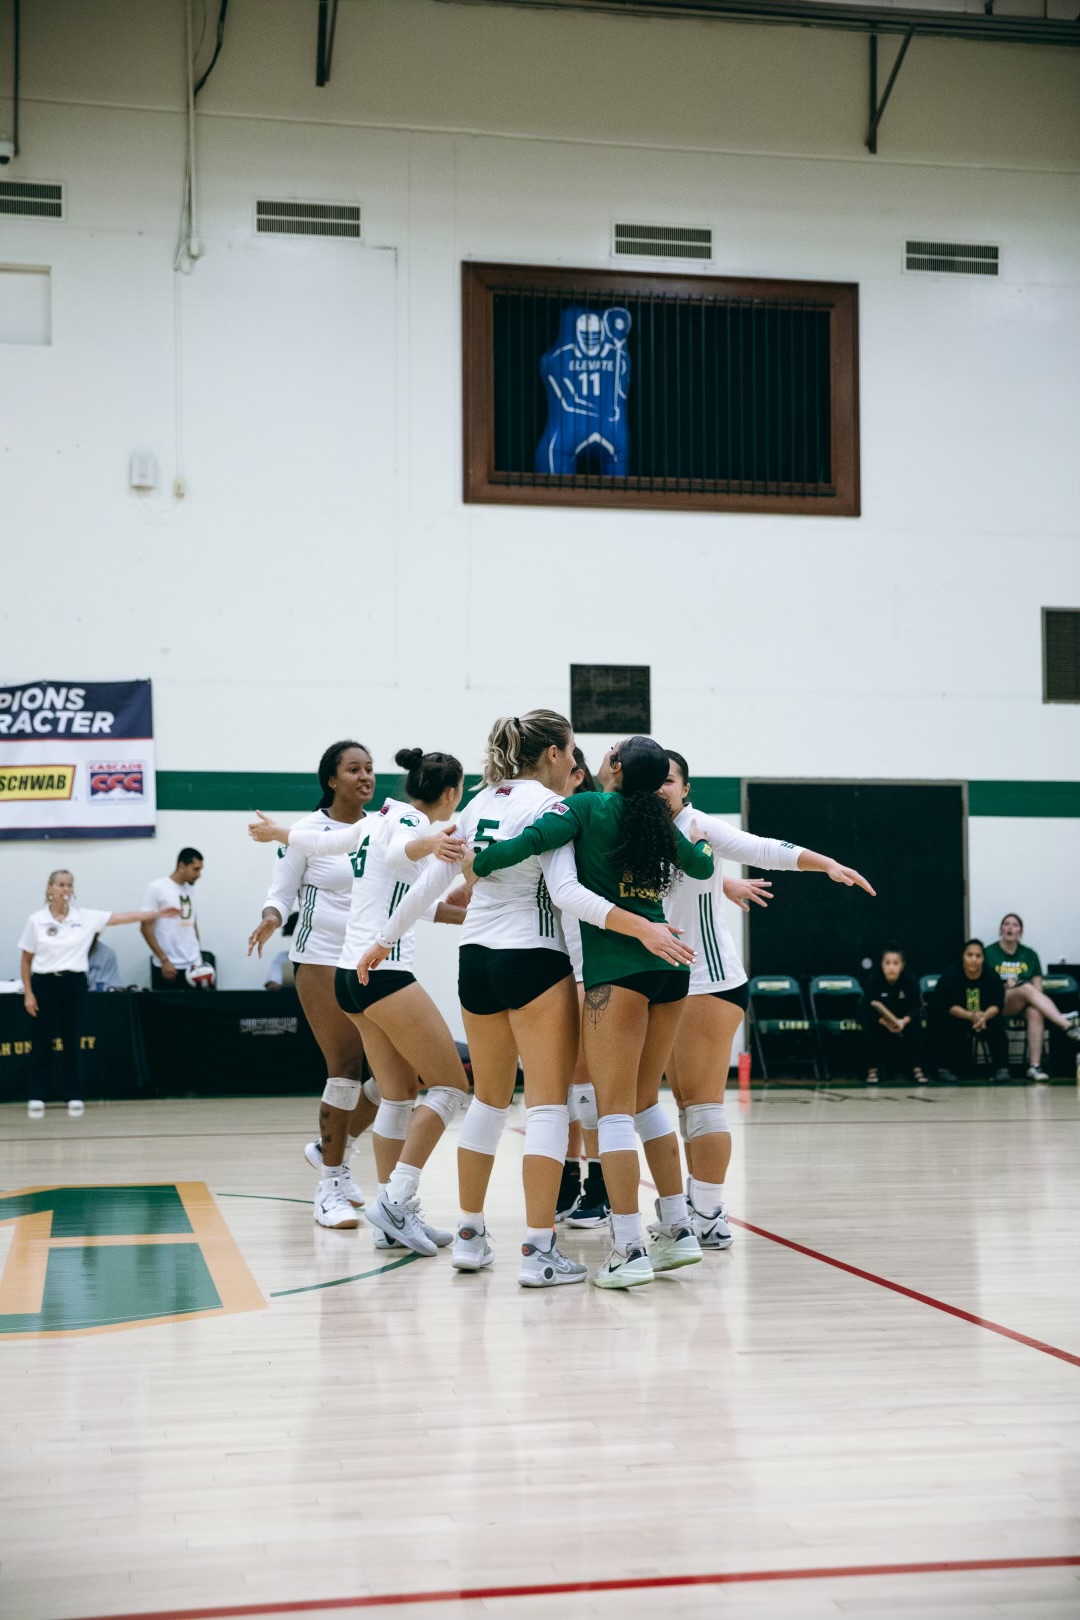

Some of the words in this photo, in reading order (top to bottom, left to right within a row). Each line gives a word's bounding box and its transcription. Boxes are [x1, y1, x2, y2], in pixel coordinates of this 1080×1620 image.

[578, 372, 601, 396] 11
[0, 710, 115, 734] RACTER
[0, 774, 67, 791] SCHWAB
